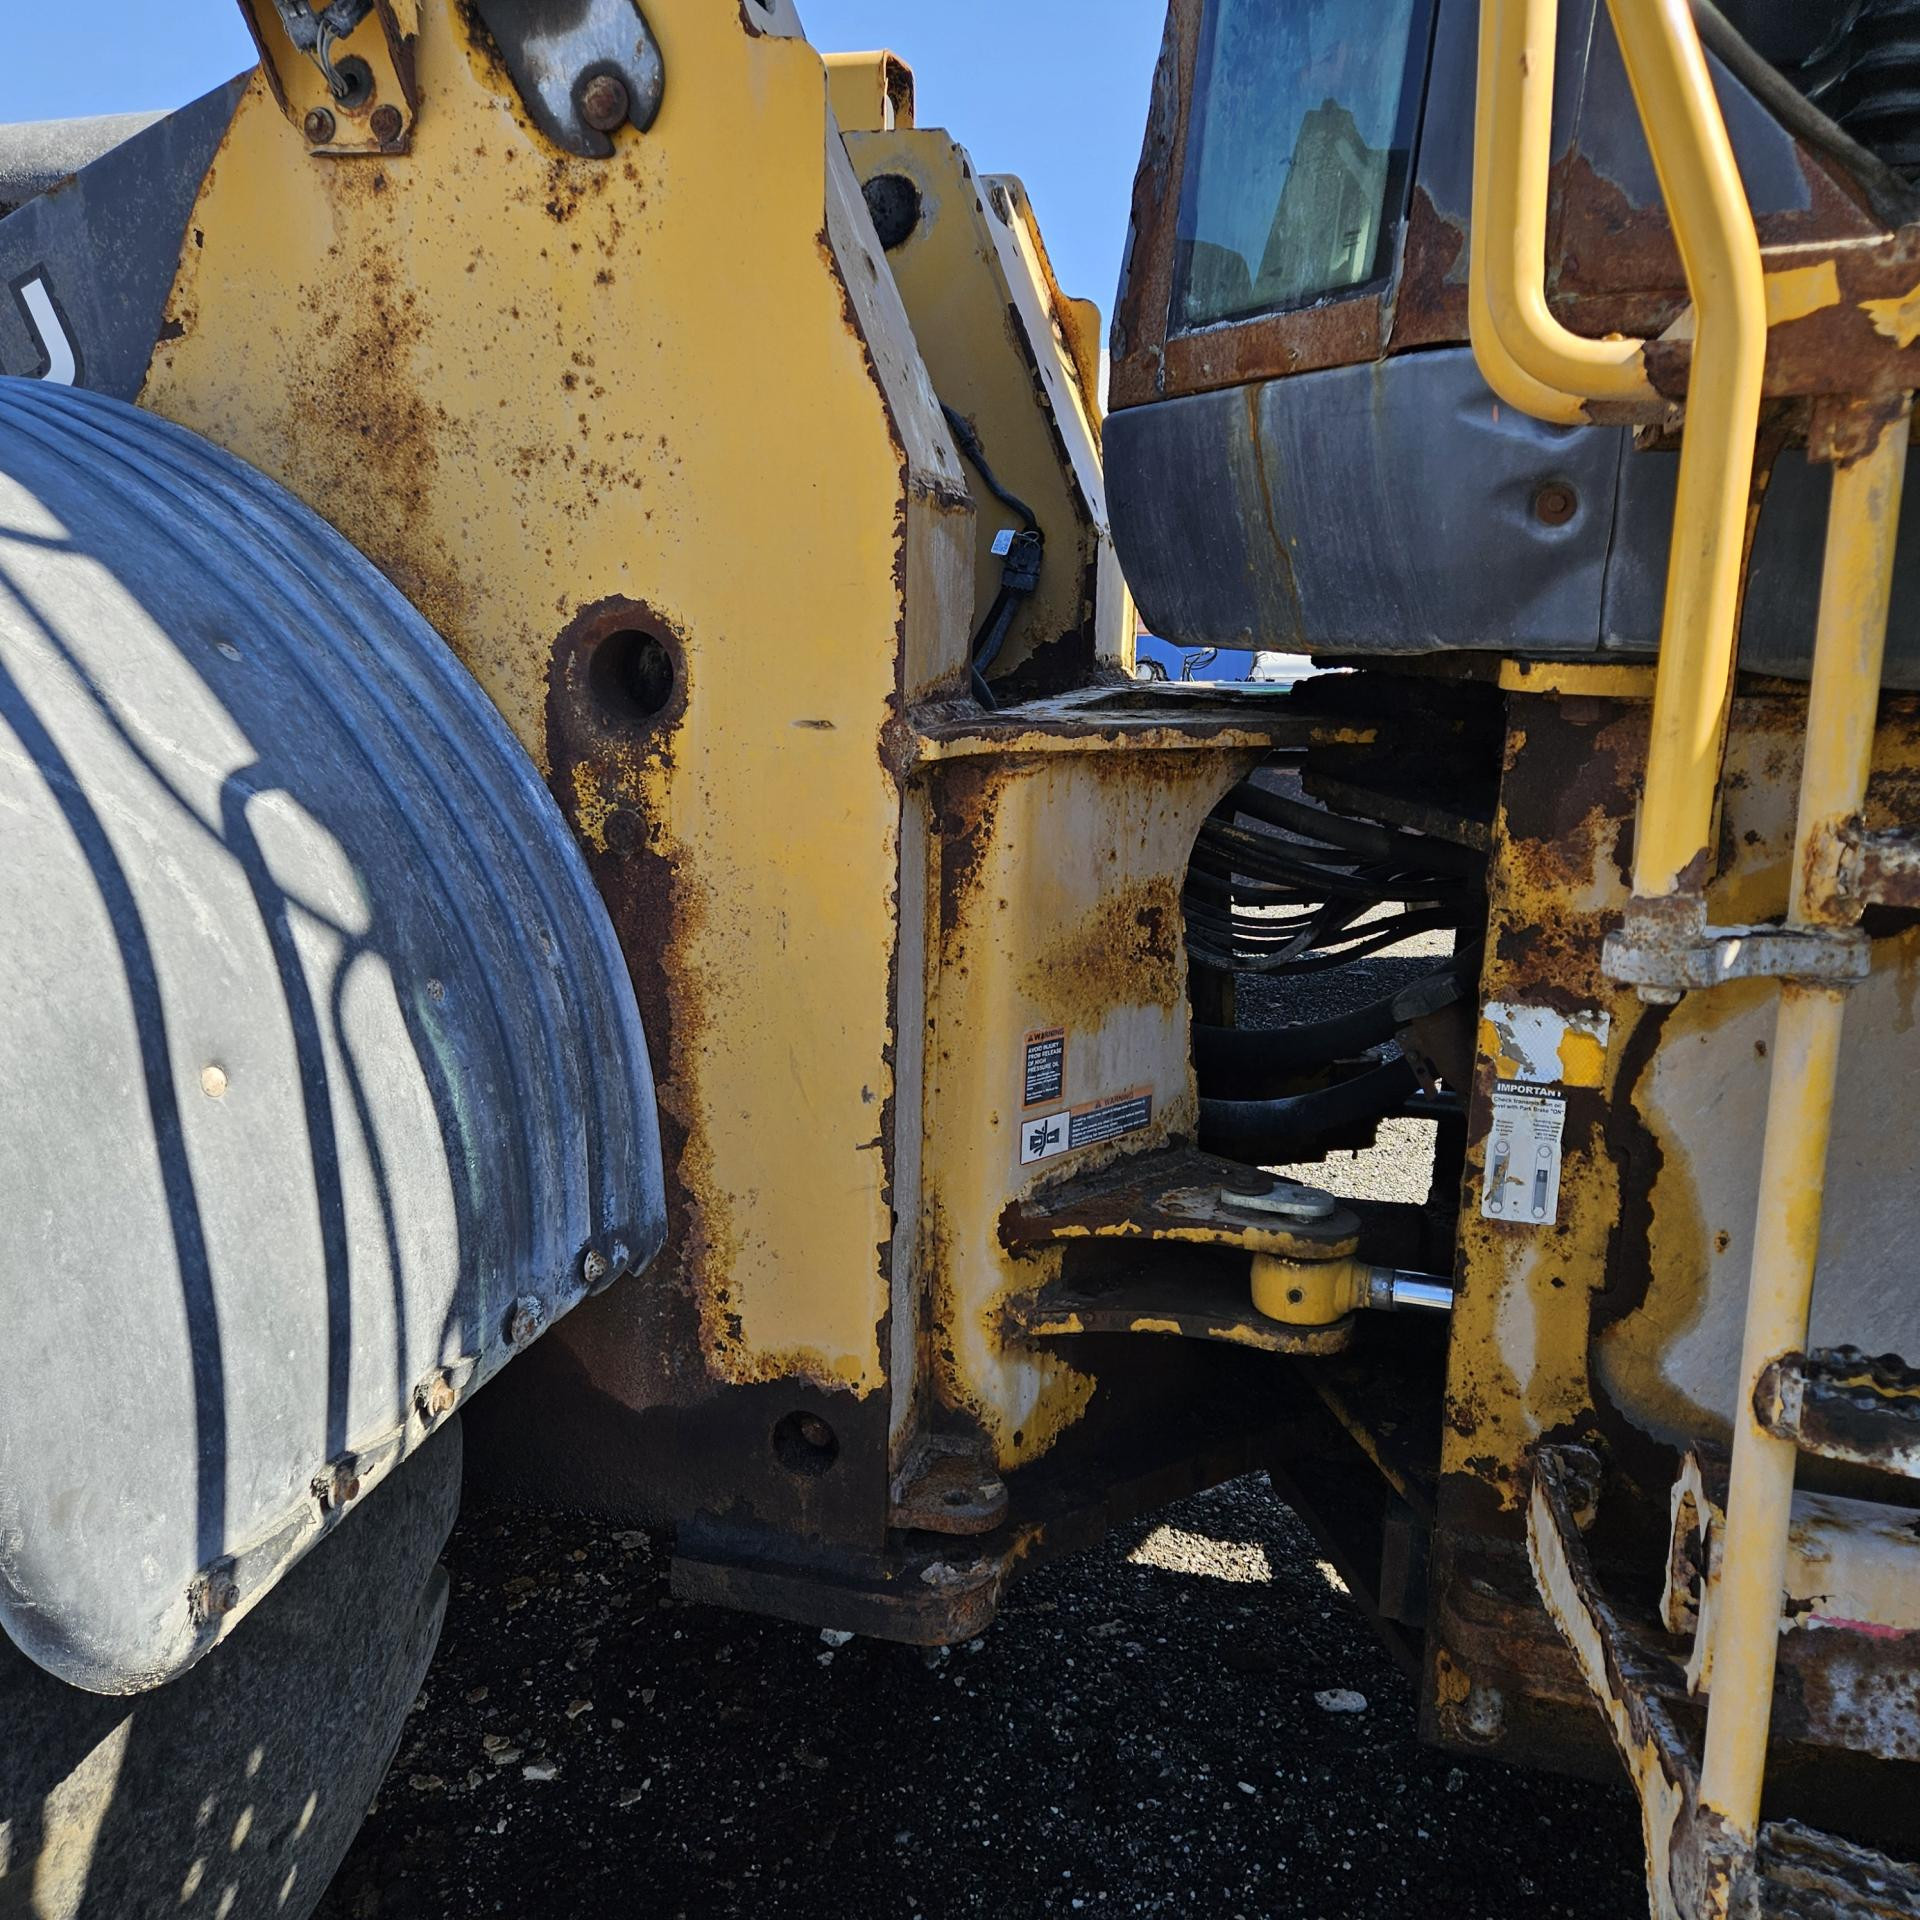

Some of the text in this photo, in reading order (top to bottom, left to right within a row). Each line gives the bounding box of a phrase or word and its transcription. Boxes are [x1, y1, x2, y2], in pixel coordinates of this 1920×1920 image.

[1028, 1042, 1059, 1053] AVOID INJURY
[1028, 1047, 1062, 1060] FROM RELEASE
[1028, 1063, 1052, 1073] PRESSURE
[1513, 1098, 1553, 1107] transmision
